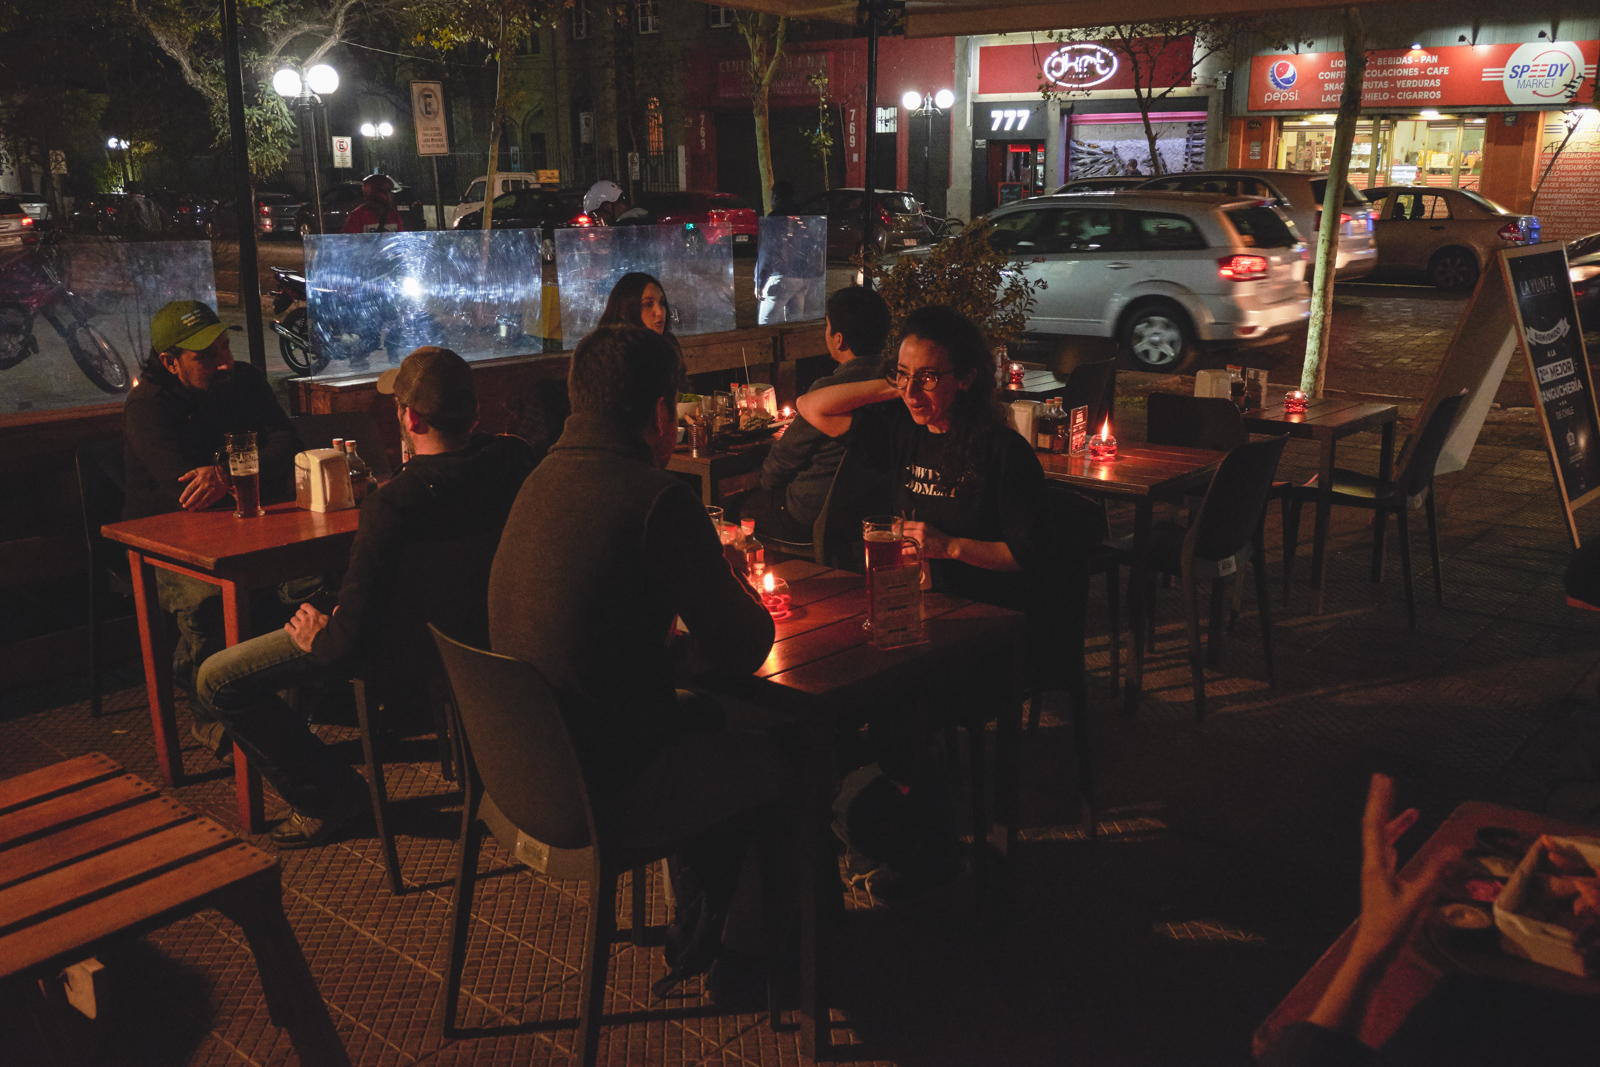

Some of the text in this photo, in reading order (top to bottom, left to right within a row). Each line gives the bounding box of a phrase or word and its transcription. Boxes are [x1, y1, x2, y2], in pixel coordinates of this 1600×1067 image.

[1377, 55, 1413, 66] BEBIDAS
[1421, 54, 1439, 64] PAN
[1365, 67, 1419, 78] COLACIONES
[1427, 66, 1450, 76] CAFE
[1508, 62, 1570, 79] SPEEDY
[1324, 79, 1441, 91] SNAC RUTAS VERDURAS
[1516, 78, 1557, 89] MARKET
[1264, 90, 1299, 104] pepsi
[1365, 92, 1389, 101] HIELO
[1396, 91, 1442, 100] CIGARROS
[991, 109, 1031, 131] 777
[1519, 275, 1557, 296] LA YUNTA
[1534, 327, 1561, 341] BIENVENIDO
[1549, 361, 1574, 378] MEJOR
